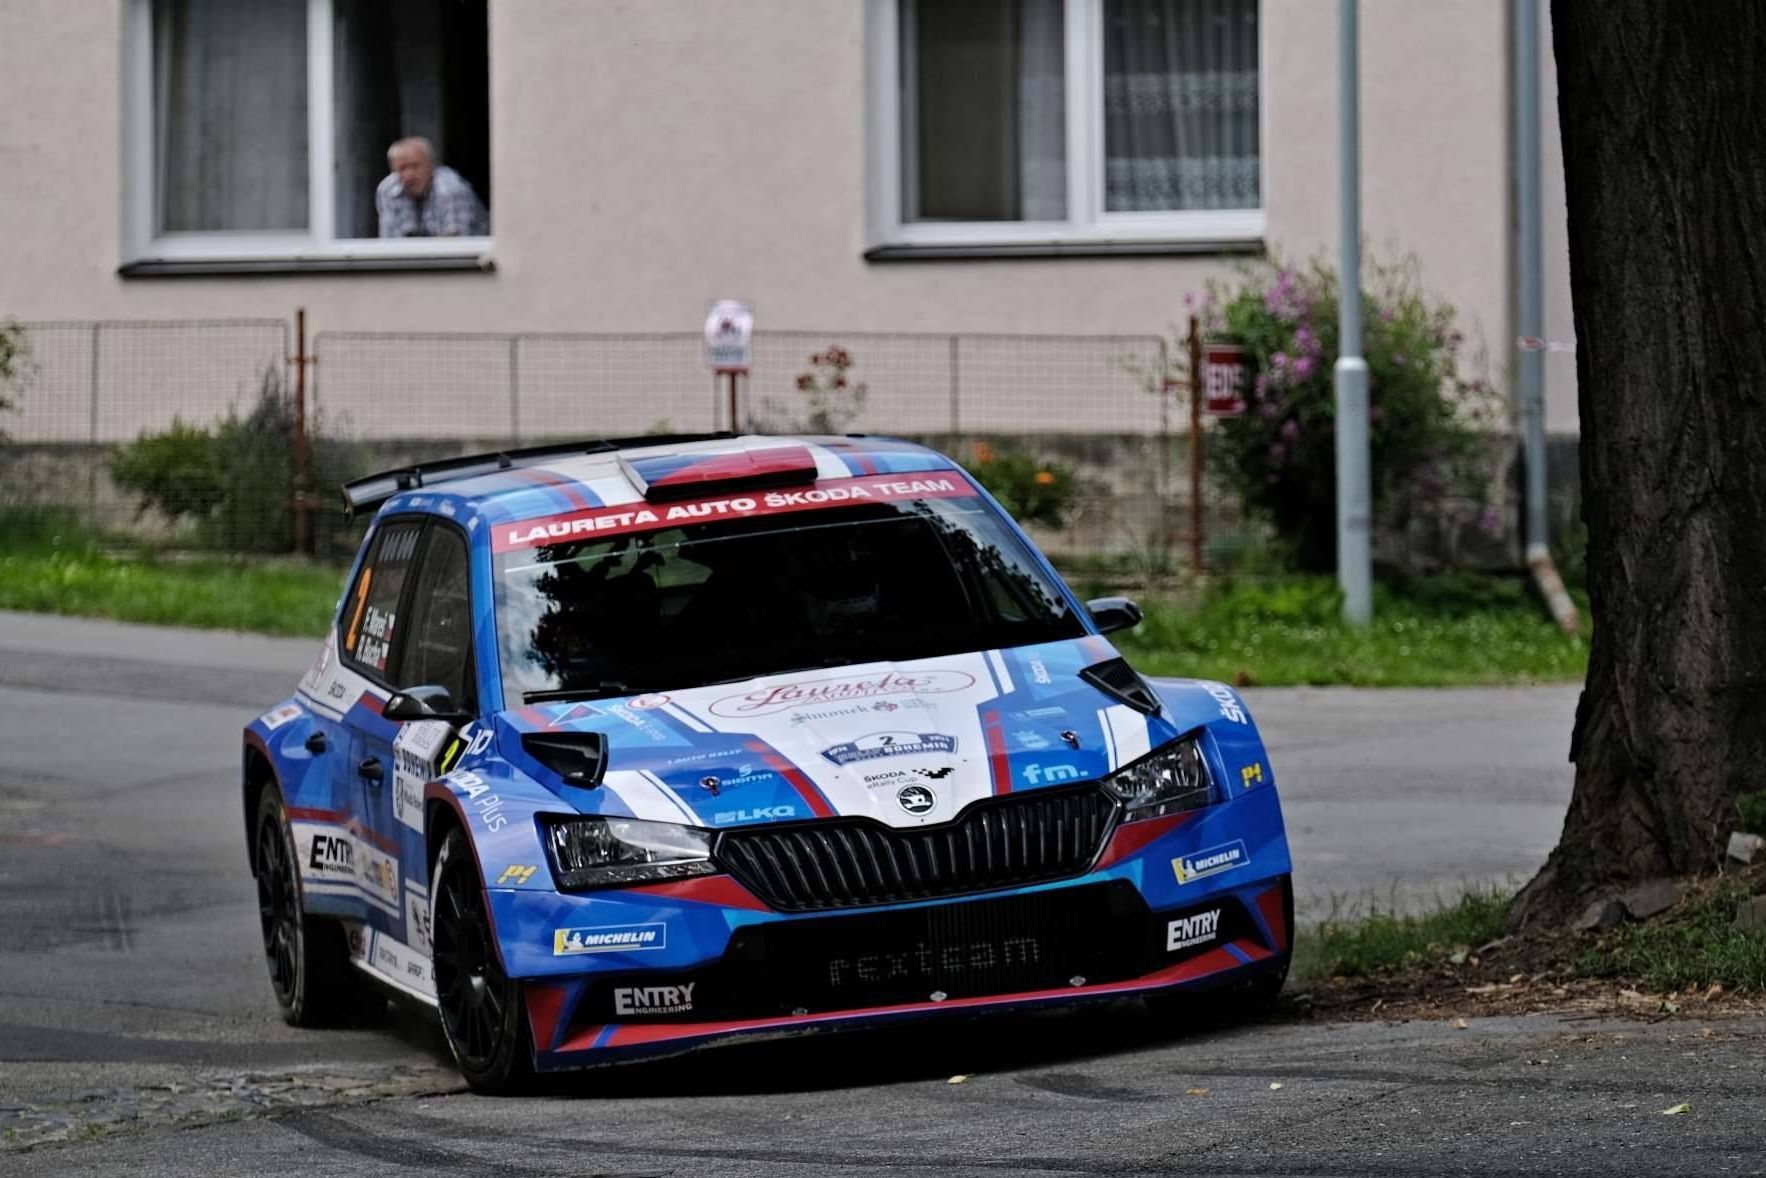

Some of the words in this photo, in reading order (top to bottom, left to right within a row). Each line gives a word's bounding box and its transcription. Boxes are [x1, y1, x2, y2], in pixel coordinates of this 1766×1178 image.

[508, 510, 659, 545] LAURETA
[666, 497, 757, 521] AUTO
[763, 484, 869, 511] ŠKODA
[873, 479, 955, 497] TEAM
[879, 735, 897, 747] 2
[737, 805, 796, 820] LKQ
[1195, 848, 1241, 871] MICHELIN
[585, 930, 656, 946] MICHELIN
[1166, 908, 1221, 951] ENTRY
[828, 936, 1041, 987] rexteam
[613, 981, 696, 1015] ENTRY
